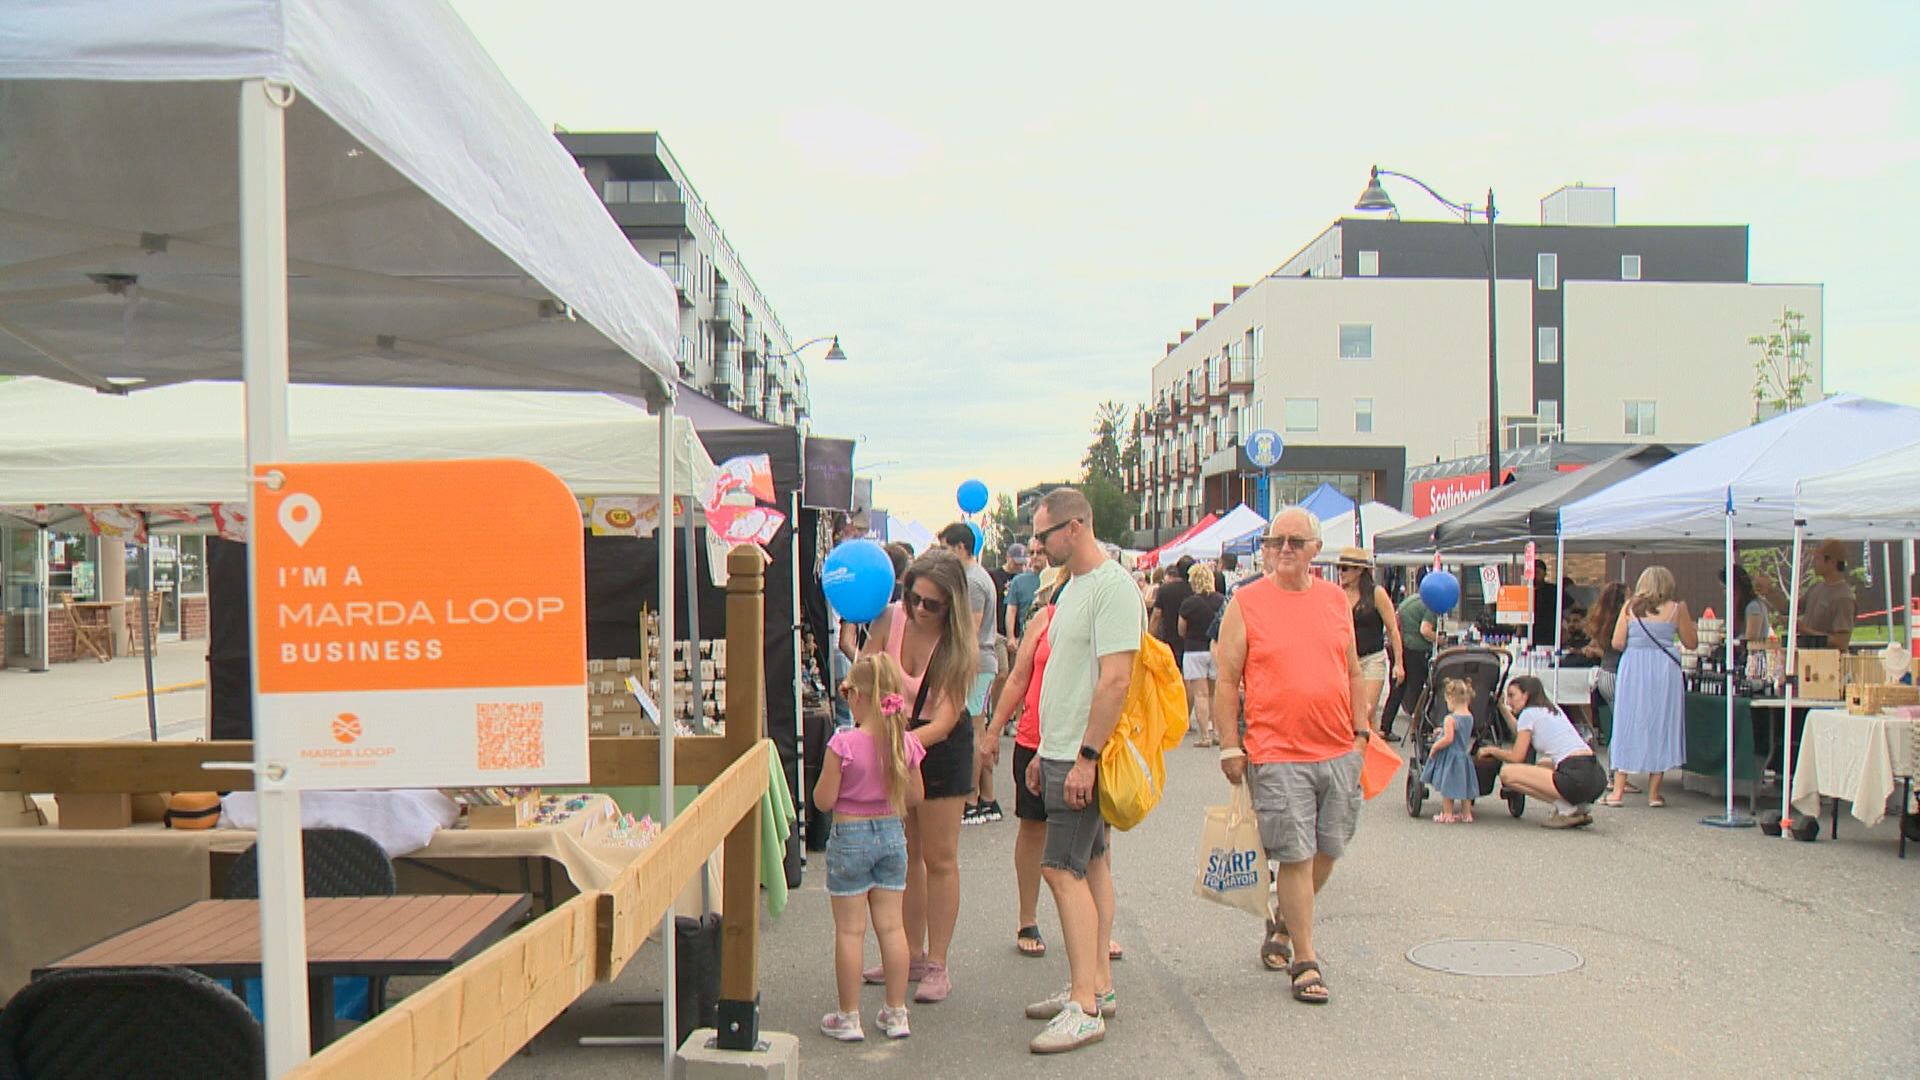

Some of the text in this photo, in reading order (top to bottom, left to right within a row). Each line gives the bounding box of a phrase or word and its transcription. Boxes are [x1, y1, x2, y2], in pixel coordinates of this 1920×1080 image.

[278, 565, 363, 588] I'M A
[279, 597, 565, 628] MARDA LOOP
[281, 639, 443, 663] BUSINESS
[300, 746, 396, 759] MARDA LOOP
